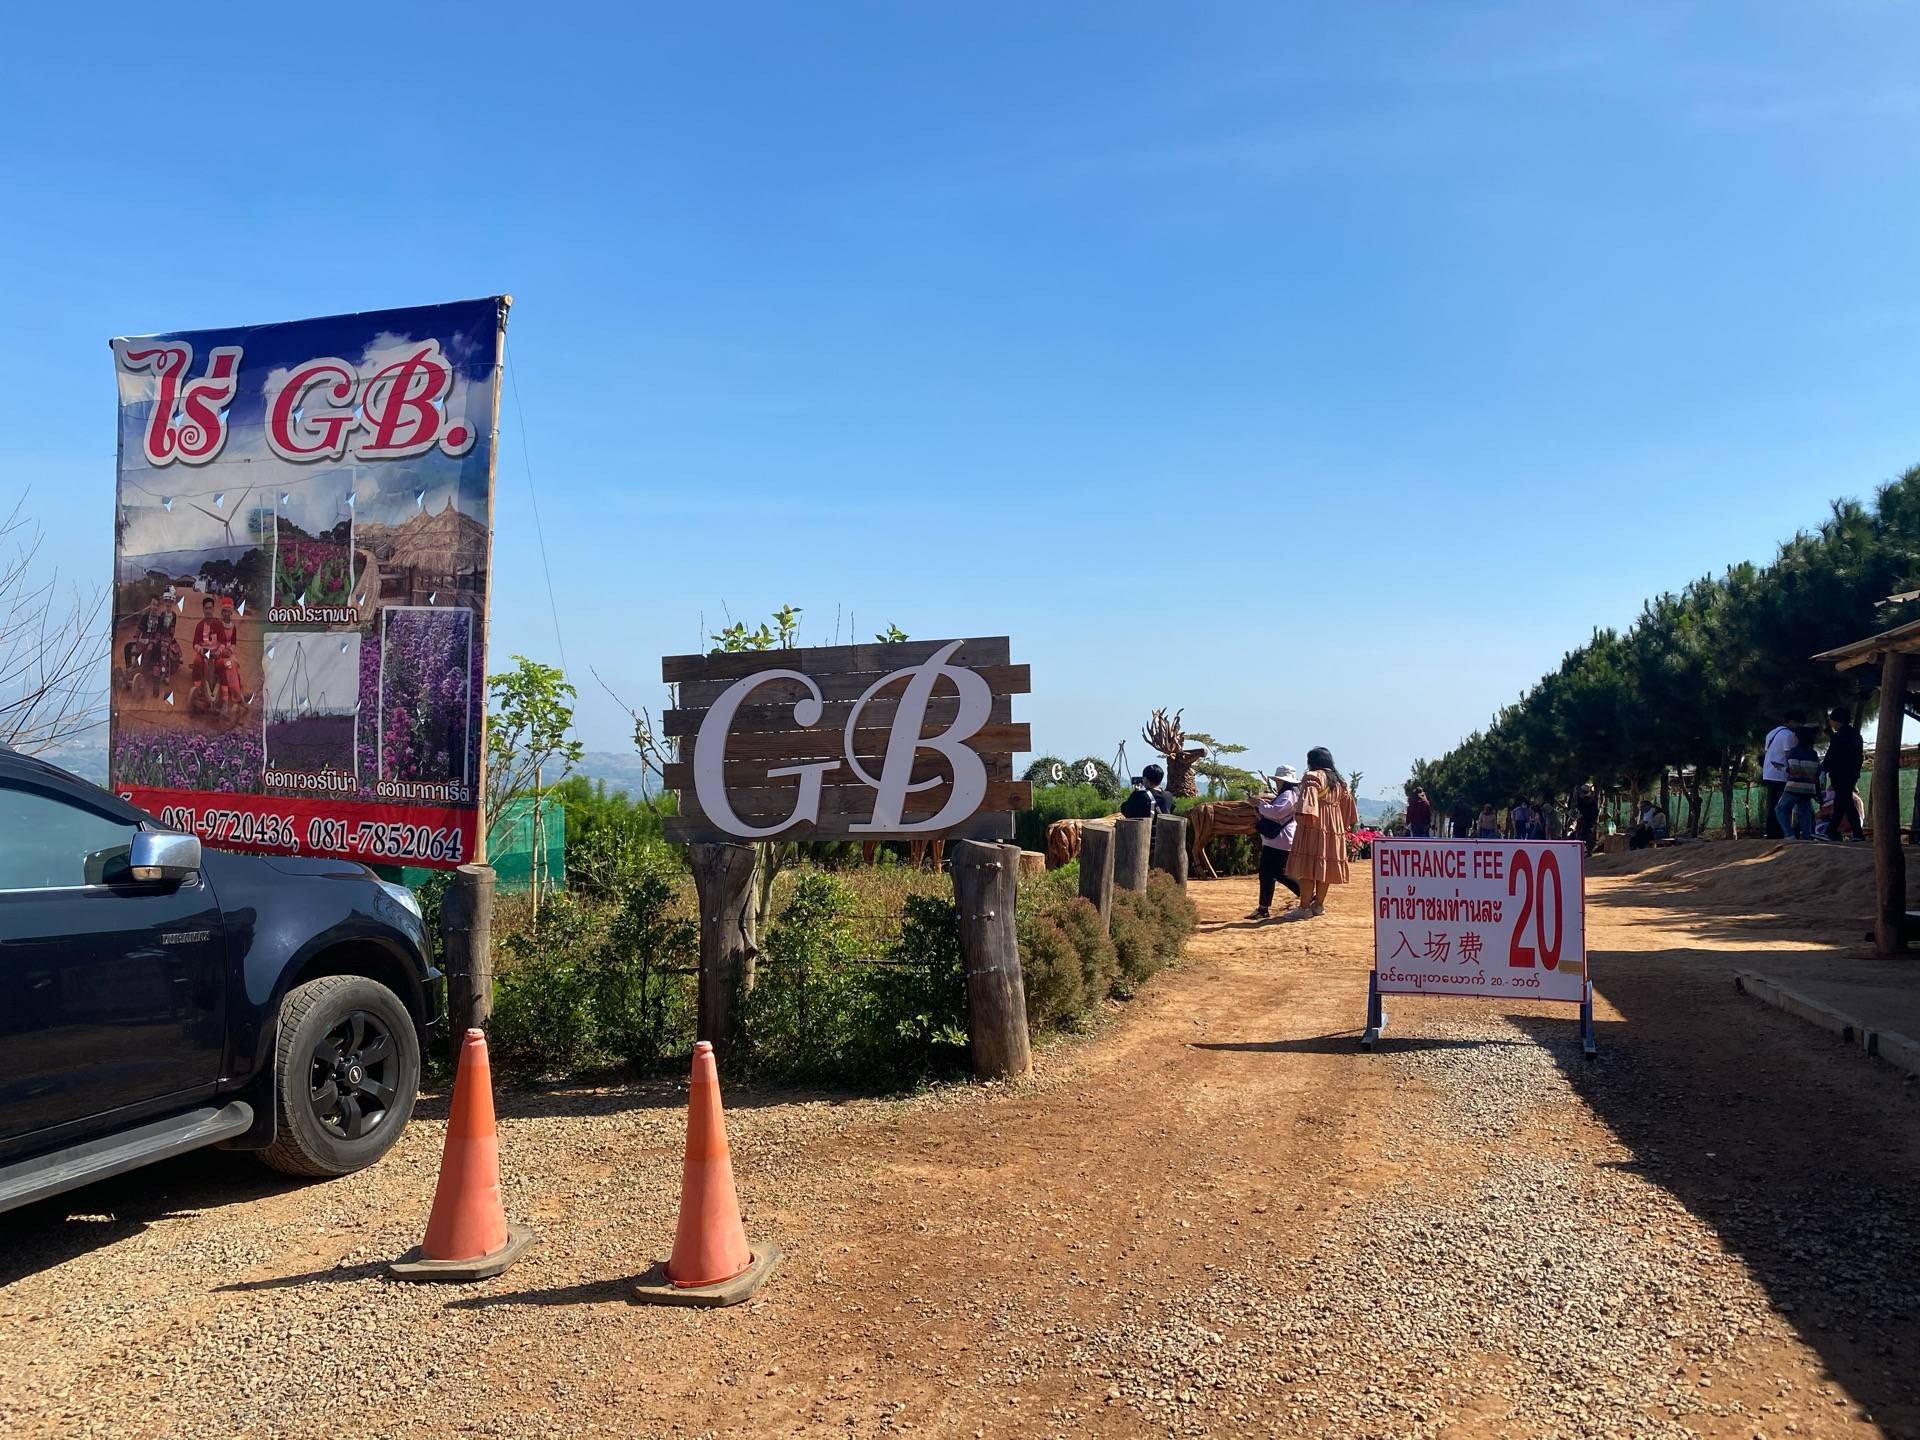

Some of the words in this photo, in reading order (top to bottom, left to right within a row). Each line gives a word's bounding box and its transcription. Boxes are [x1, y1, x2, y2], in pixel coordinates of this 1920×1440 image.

[124, 341, 242, 464] ไร่
[266, 338, 478, 463] GB.
[692, 639, 994, 838] GB
[309, 818, 462, 862] 081-7852064
[1379, 849, 1467, 878] ENTRANCE
[1473, 850, 1504, 880] FEE
[1379, 884, 1503, 923] ค่าเข้าชมท่านละ
[1508, 848, 1563, 971] 20
[1390, 930, 1484, 966] 入场费
